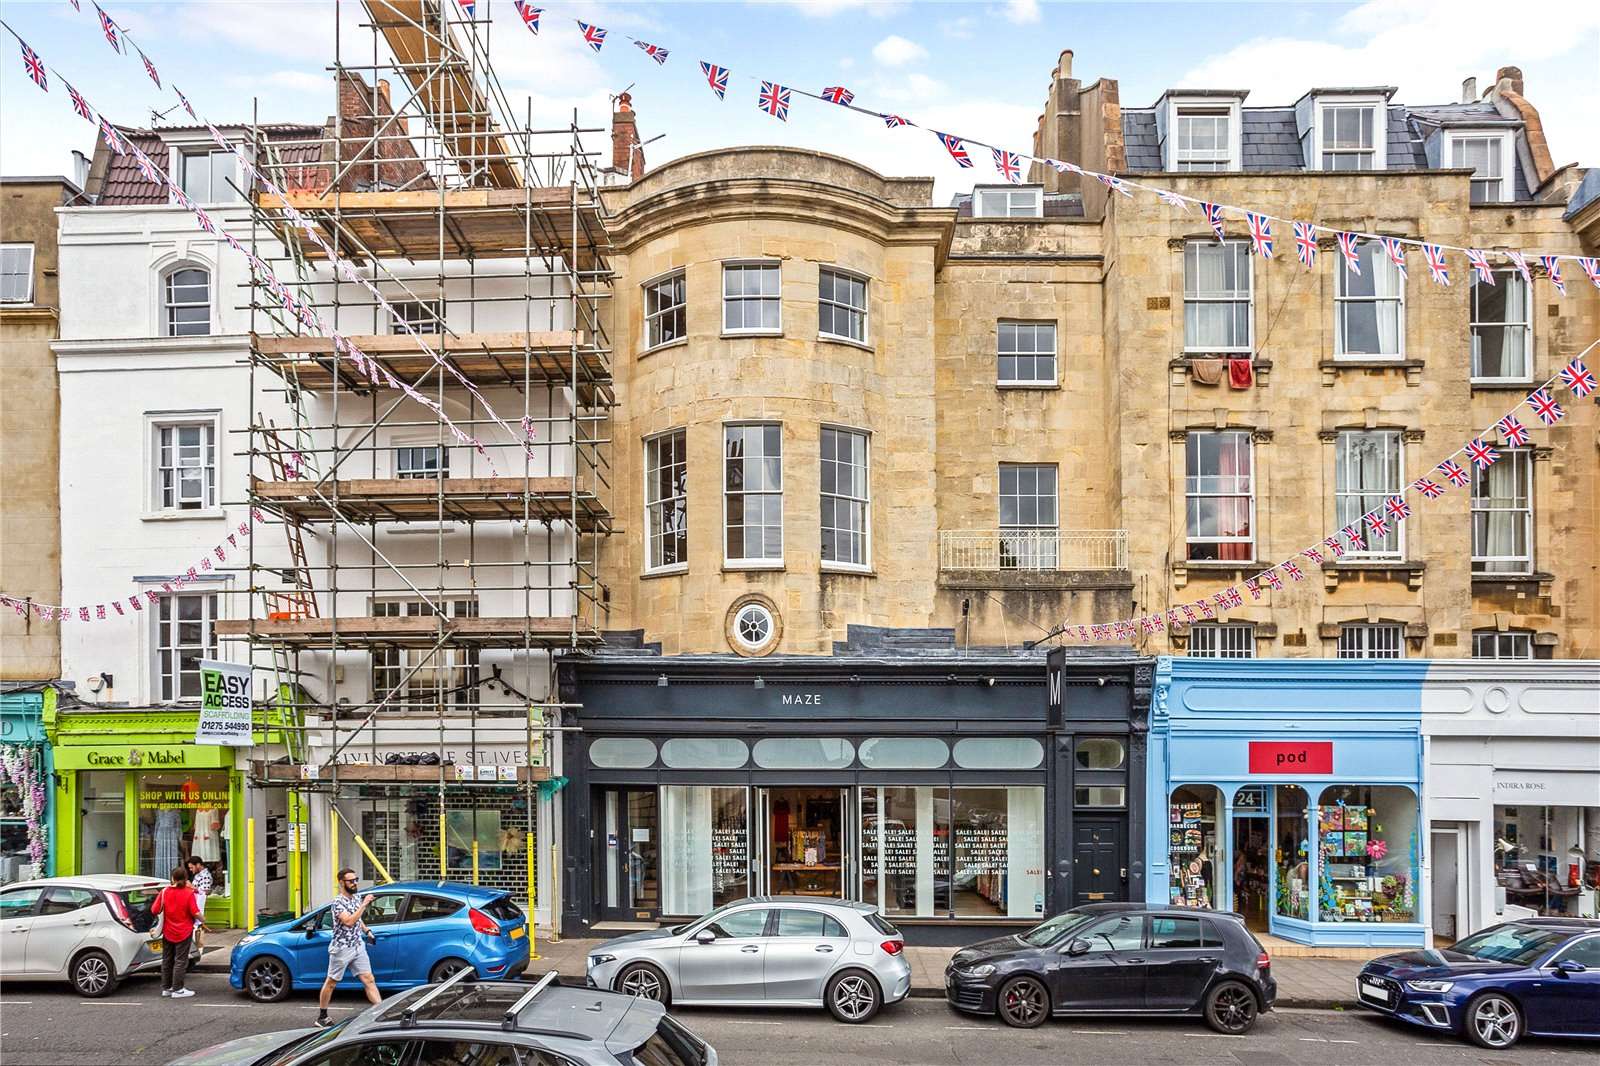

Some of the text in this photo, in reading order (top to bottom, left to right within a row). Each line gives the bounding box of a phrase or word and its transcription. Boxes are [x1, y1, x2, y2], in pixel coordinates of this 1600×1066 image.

[204, 673, 249, 695] EASY
[1050, 671, 1060, 706] M
[204, 694, 249, 709] ACCESS
[782, 694, 822, 705] MAZE
[203, 710, 250, 720] SCAFFOLDING
[201, 721, 249, 731] 01275 544990
[87, 751, 124, 765] Grace
[148, 750, 185, 764] Mabel
[1276, 751, 1307, 765] pod
[1525, 782, 1544, 790] ROSE
[140, 792, 162, 800] SHOP
[165, 792, 186, 800] WITH
[189, 792, 200, 800] US
[1237, 793, 1255, 806] 24
